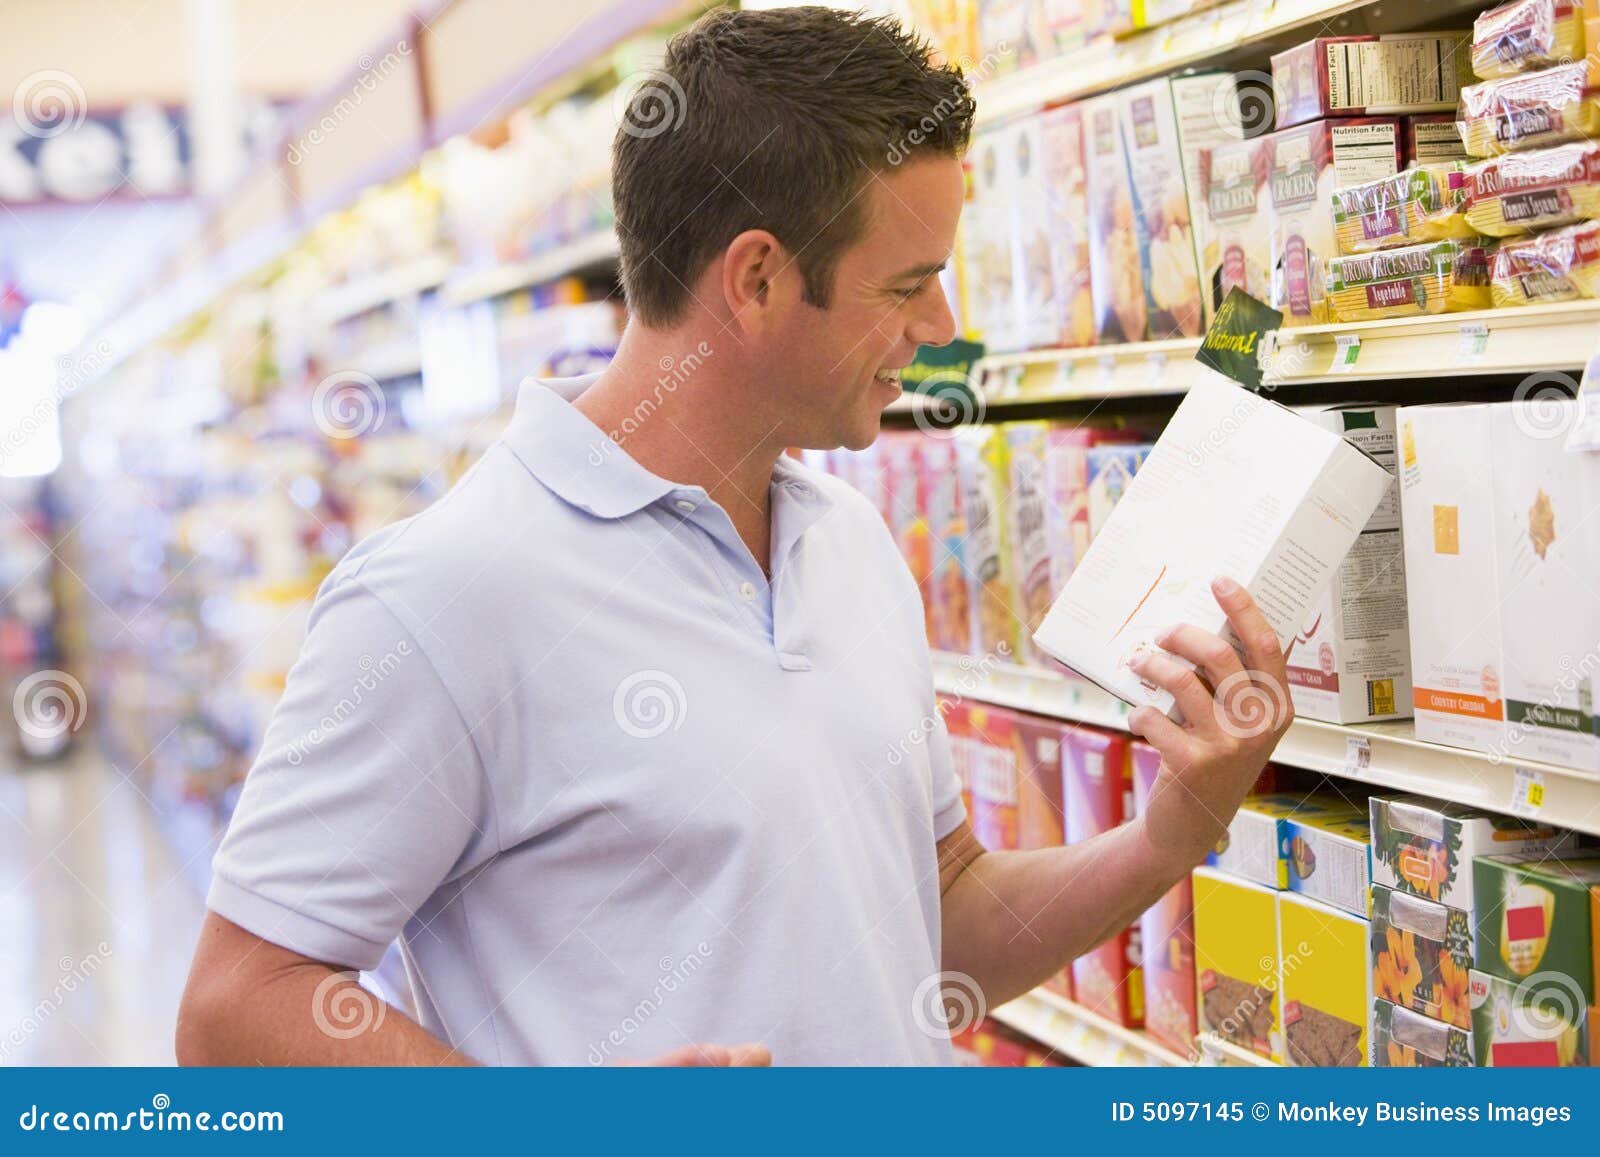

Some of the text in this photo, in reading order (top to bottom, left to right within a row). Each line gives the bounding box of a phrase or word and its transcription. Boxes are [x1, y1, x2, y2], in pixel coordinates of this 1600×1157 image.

[1333, 125, 1394, 135] Nutrition Facts
[1275, 174, 1316, 200] CRACKERS
[1364, 212, 1394, 234] Vegble
[1343, 257, 1374, 282] BROWN
[1376, 254, 1399, 279] RICE
[1400, 250, 1431, 275] SNAPS
[1372, 280, 1407, 306] Vegetable
[1430, 695, 1486, 713] COUNTRY CHEDDAR
[1471, 981, 1487, 997] NEW
